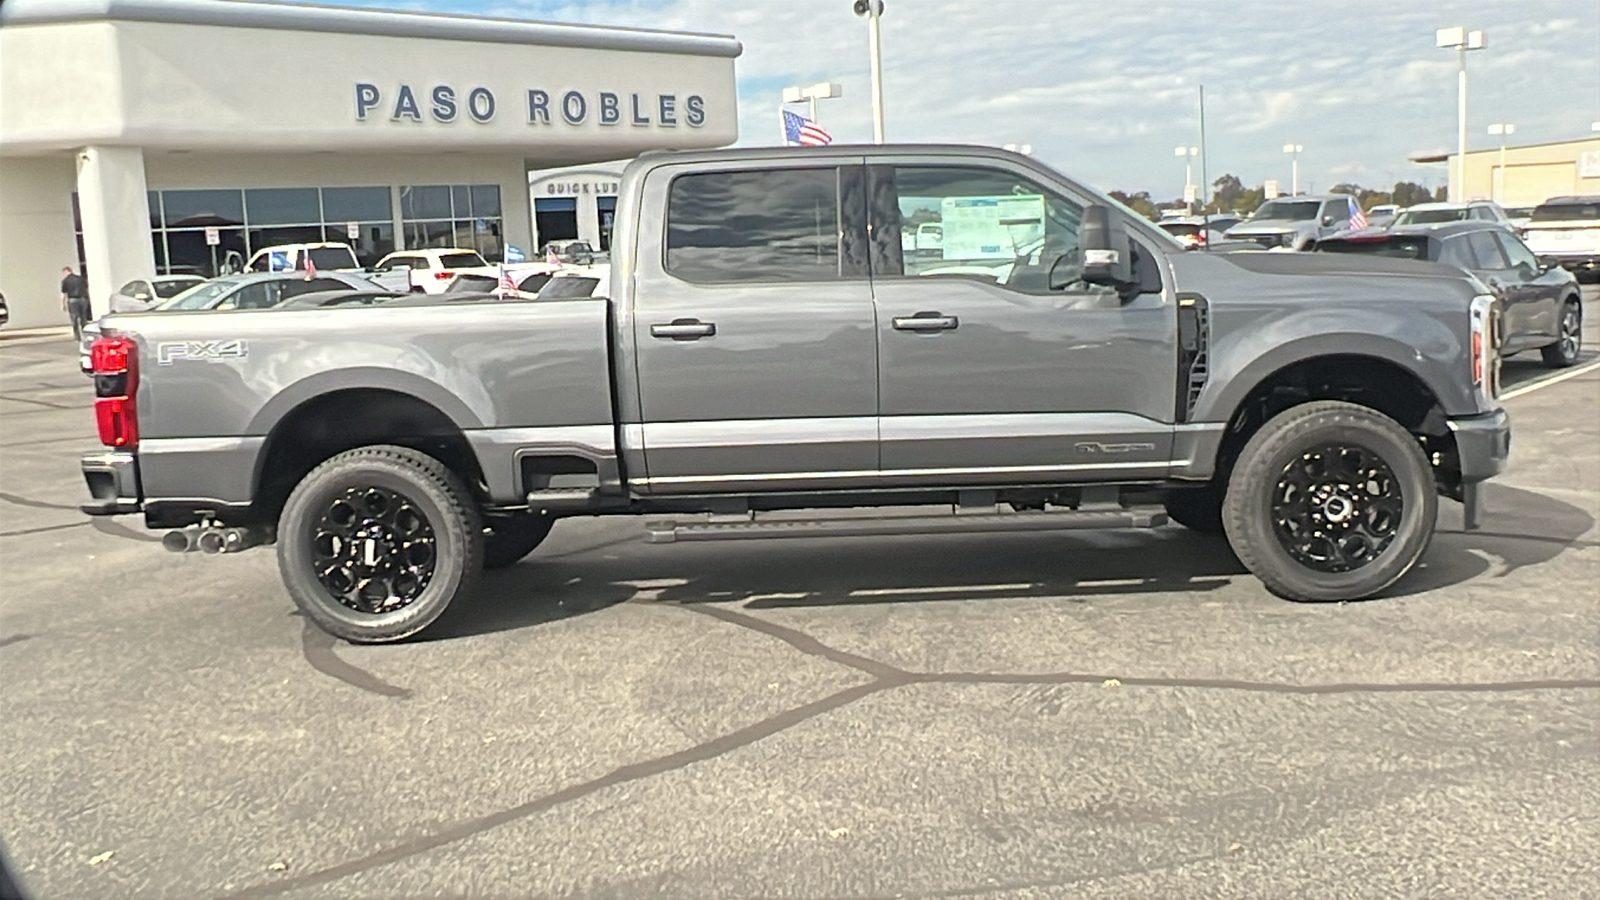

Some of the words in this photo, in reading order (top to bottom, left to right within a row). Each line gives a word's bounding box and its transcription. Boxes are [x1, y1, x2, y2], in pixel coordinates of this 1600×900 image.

[354, 82, 495, 123] PASO
[526, 88, 706, 127] ROBLES
[547, 182, 589, 195] QUICK
[157, 339, 249, 366] FX4
